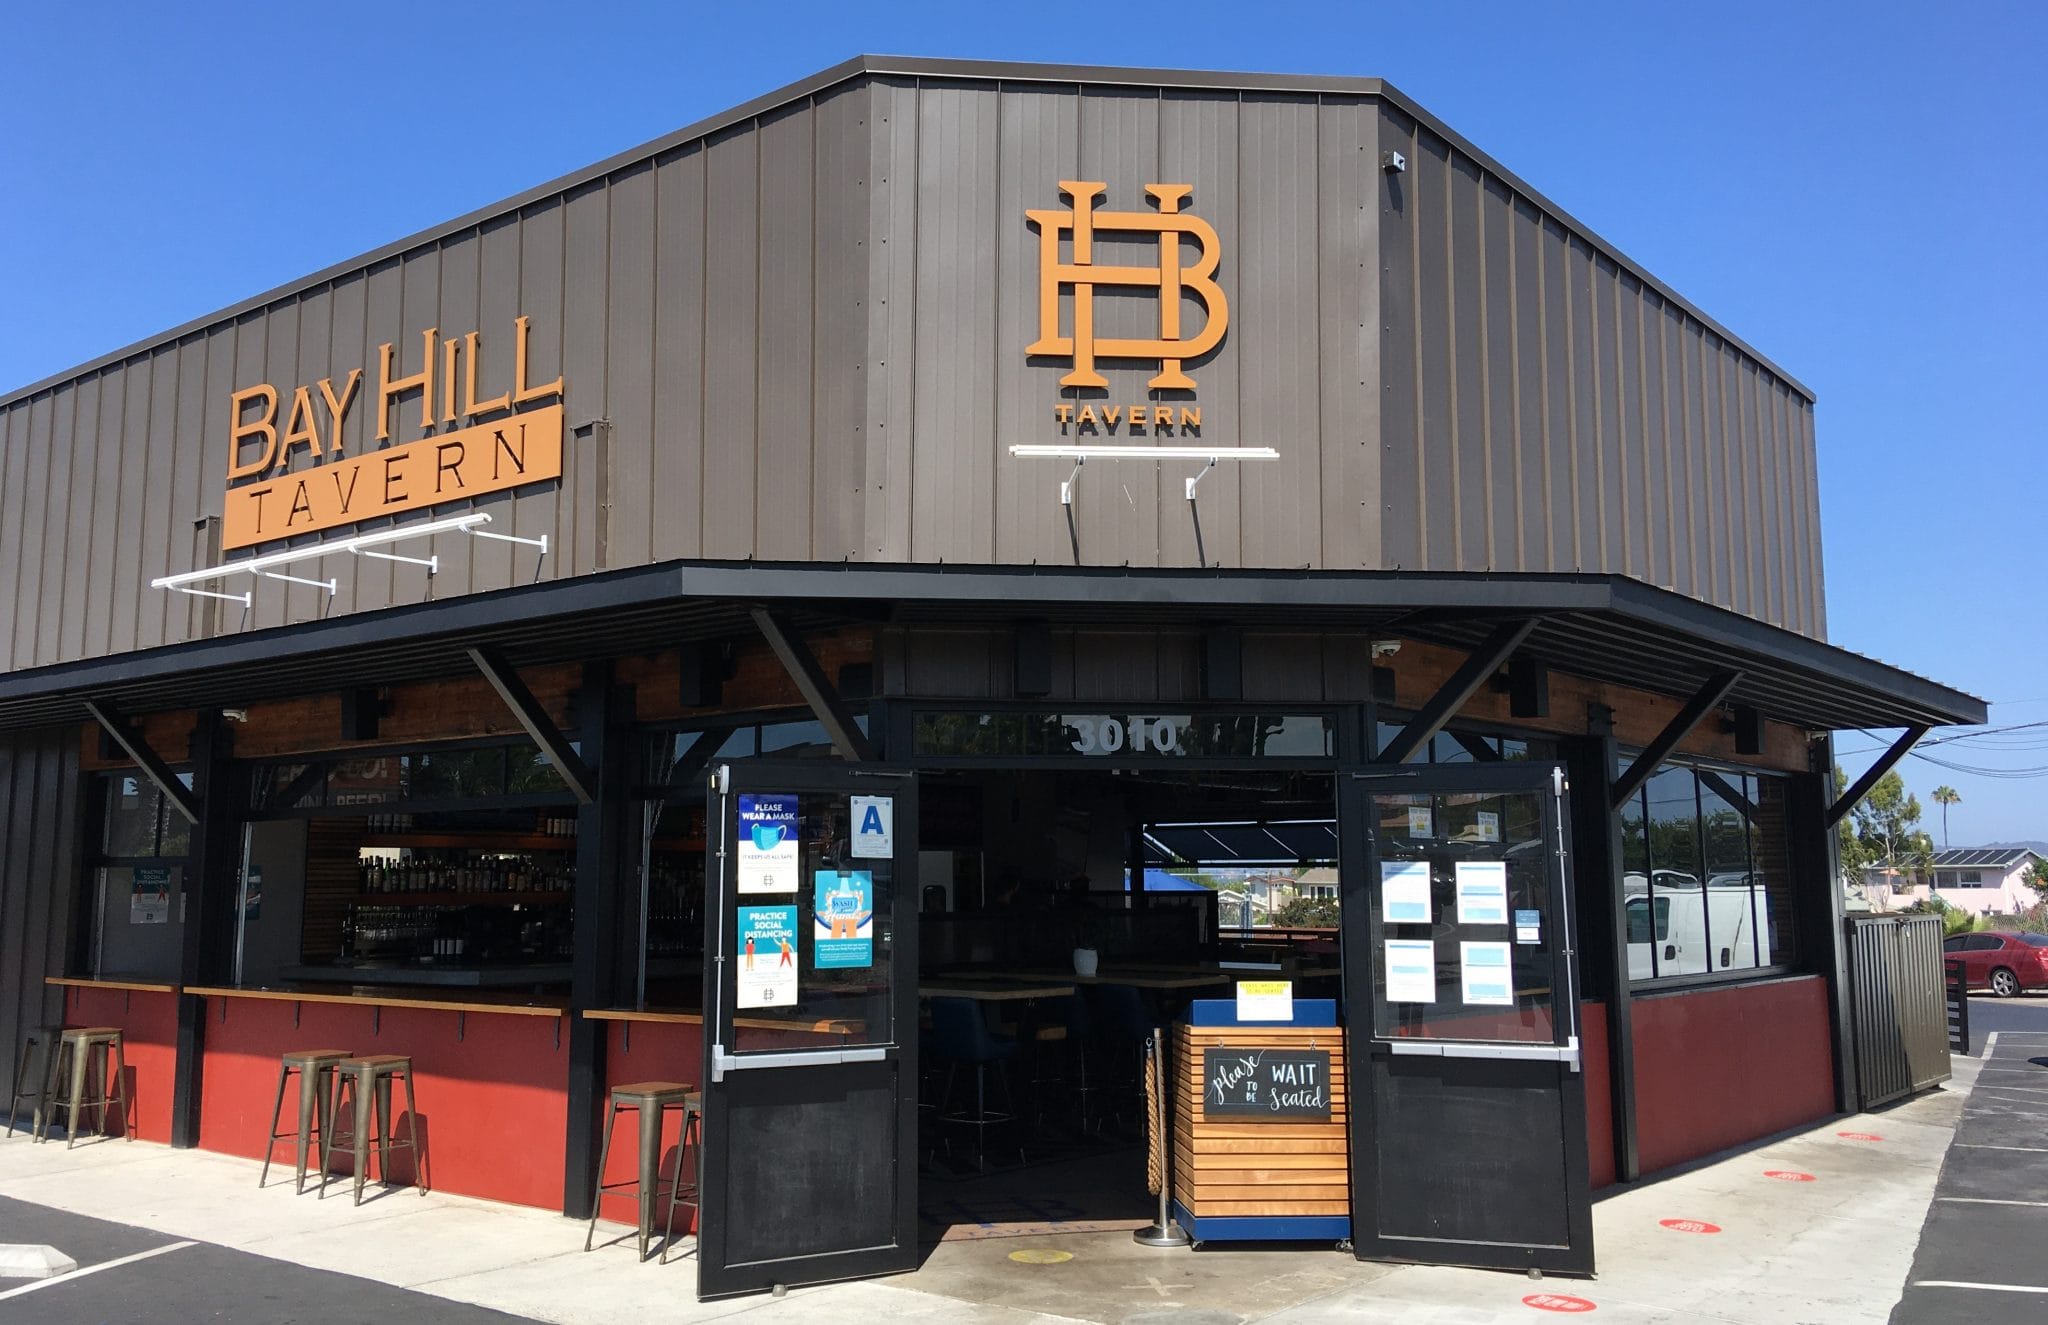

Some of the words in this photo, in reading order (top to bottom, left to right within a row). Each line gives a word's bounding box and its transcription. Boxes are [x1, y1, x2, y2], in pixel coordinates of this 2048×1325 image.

[226, 368, 363, 480] BAY
[375, 316, 564, 440] HILL
[1054, 404, 1201, 425] TAVERN
[249, 424, 526, 534] TAVERN
[1071, 718, 1177, 752] 3010
[754, 803, 783, 812] PLEASE
[742, 812, 765, 820] WEAR
[772, 812, 795, 820] MASK
[860, 805, 884, 834] A
[749, 912, 788, 921] PRACTICE
[754, 921, 783, 930] SOCIAL
[744, 930, 793, 939] DISTANCING
[1207, 1050, 1263, 1105] please
[1271, 1064, 1317, 1086] WAIT
[1246, 1081, 1258, 1091] TO
[1245, 1092, 1257, 1103] BE
